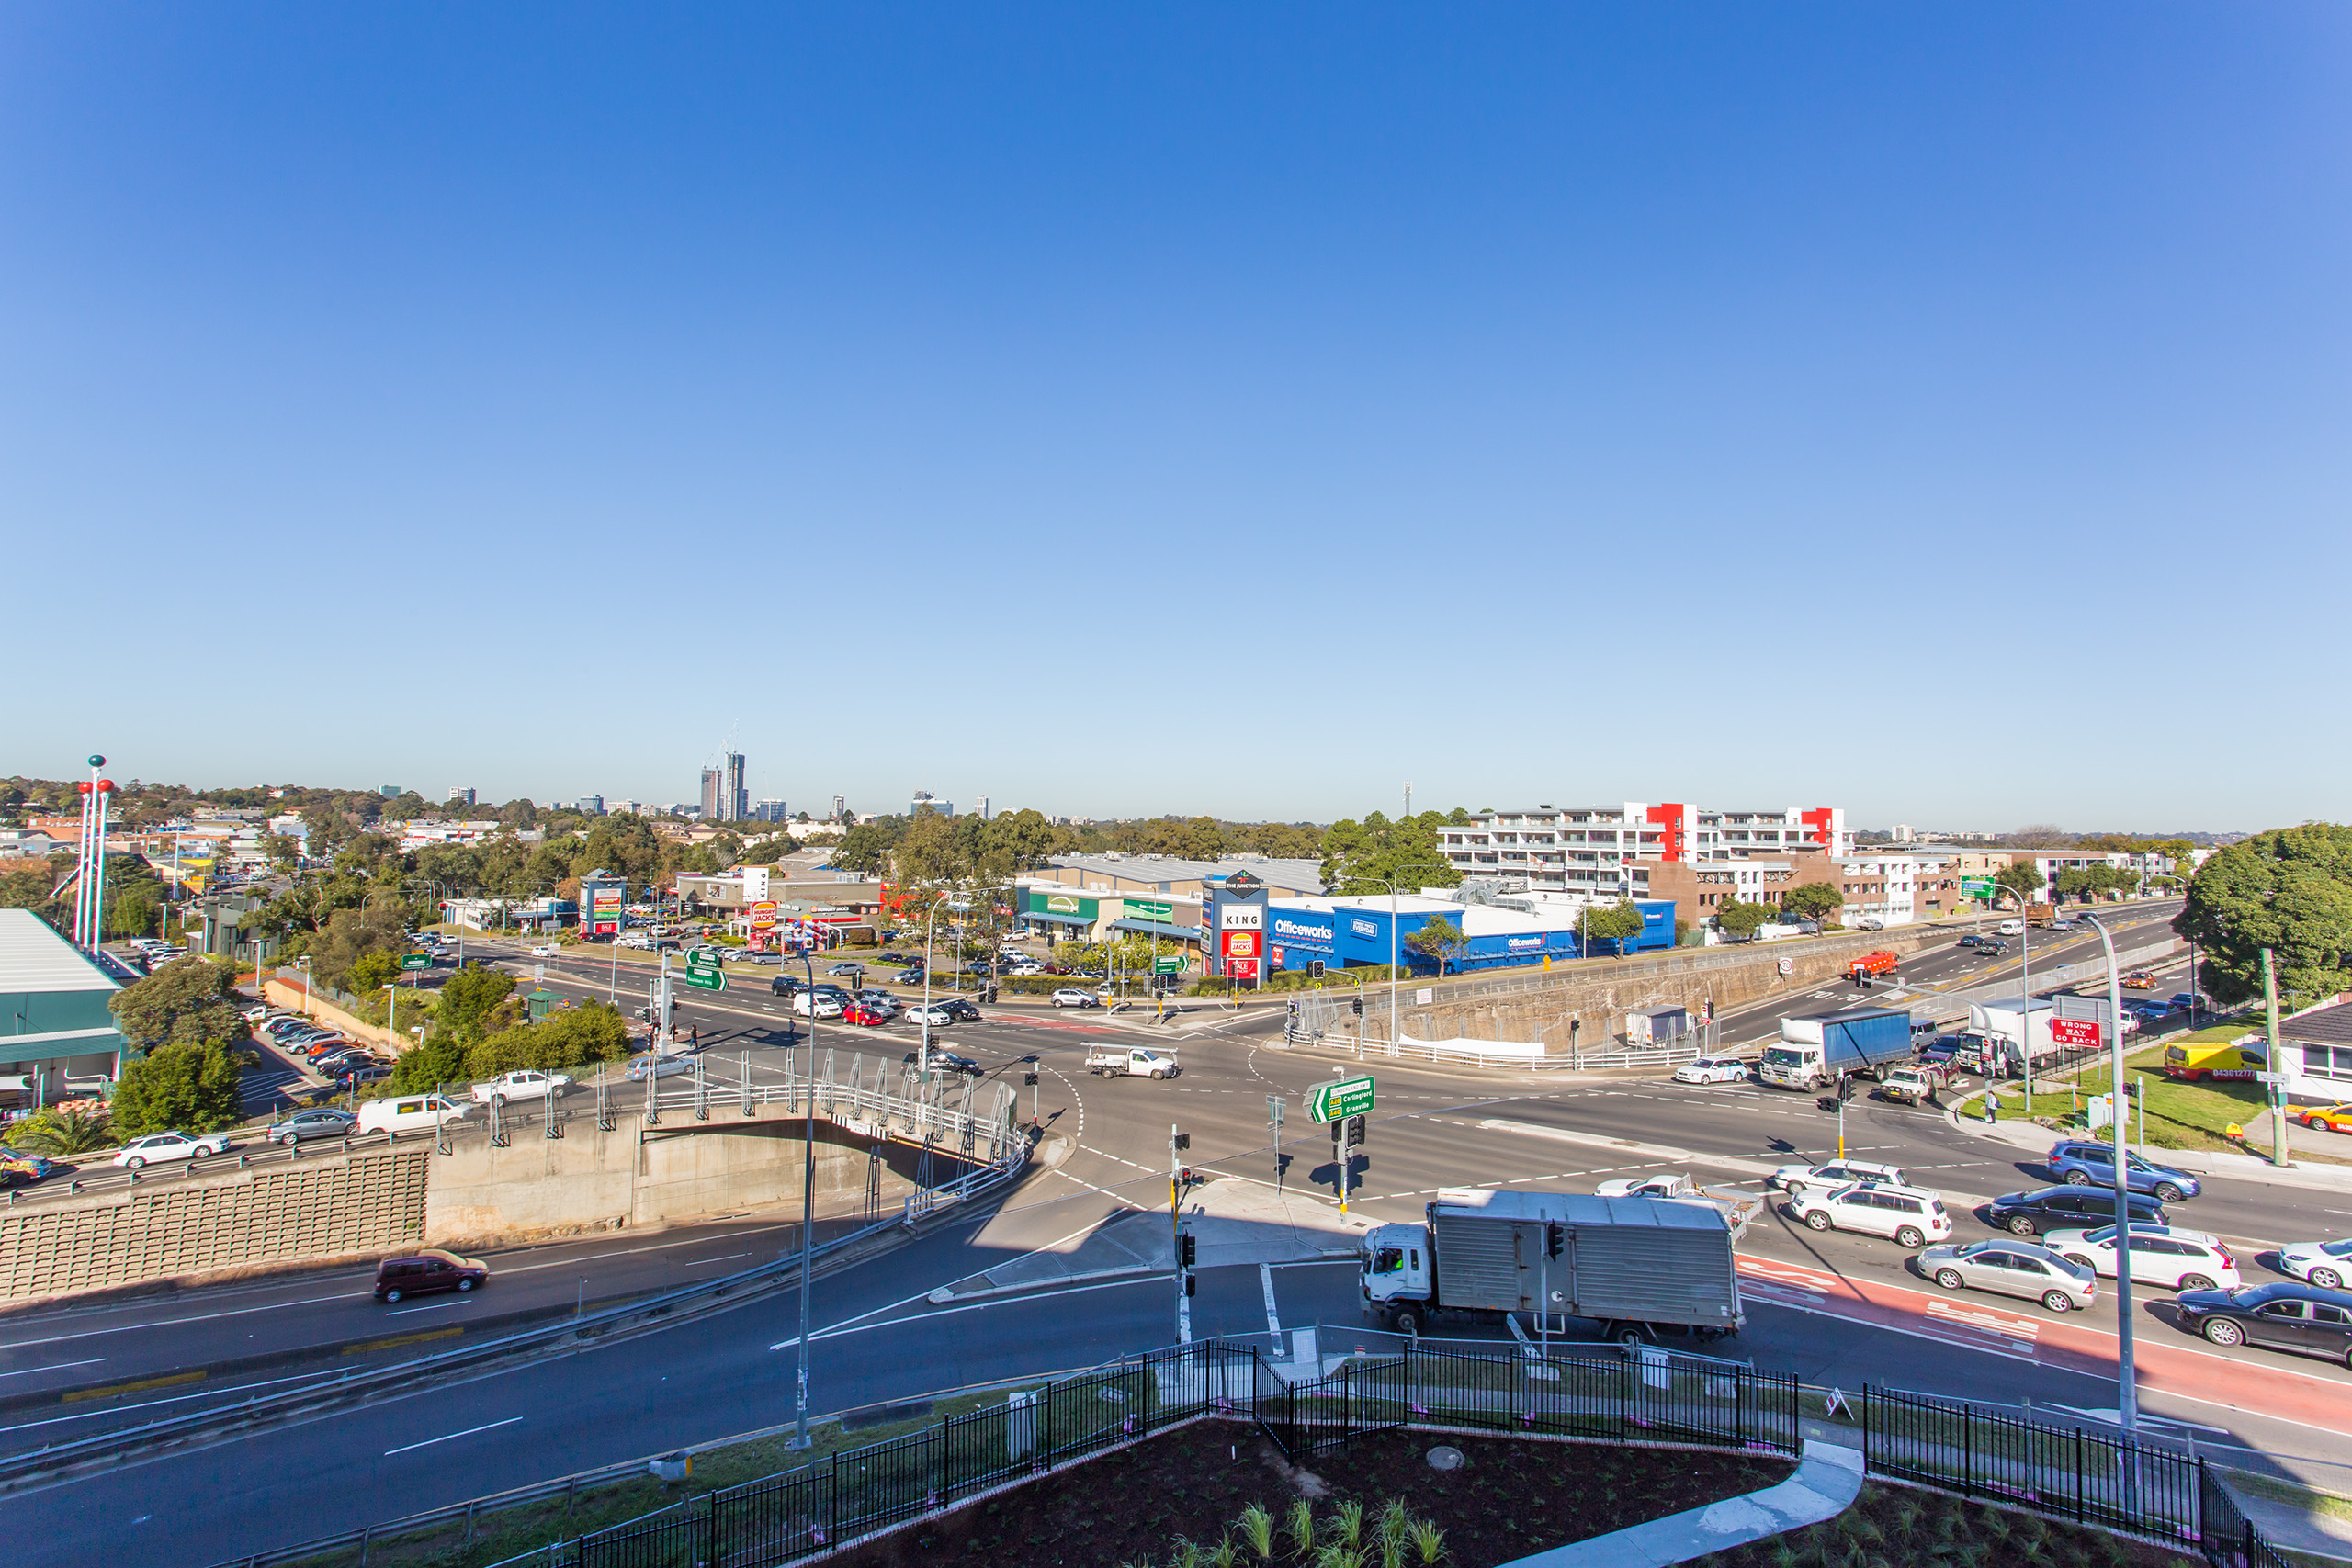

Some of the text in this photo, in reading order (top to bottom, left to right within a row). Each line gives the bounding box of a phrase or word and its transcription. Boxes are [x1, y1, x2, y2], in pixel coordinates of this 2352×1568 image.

[1047, 902, 1069, 910] drummond
[753, 914, 775, 922] JACK'S
[1226, 916, 1258, 924] KING
[1275, 919, 1332, 939] Officeworks
[1508, 937, 1542, 947] Officeworks
[2060, 1021, 2092, 1030] WRONG
[2065, 1028, 2086, 1036] WAY
[2072, 1036, 2098, 1045] BACK
[1332, 1085, 1359, 1094] CUMBERLAND
[1343, 1090, 1372, 1102] Carlingford
[1346, 1102, 1369, 1112] Granville
[1736, 1261, 1836, 1304] BUS
[1919, 1302, 2039, 1354] LANE
